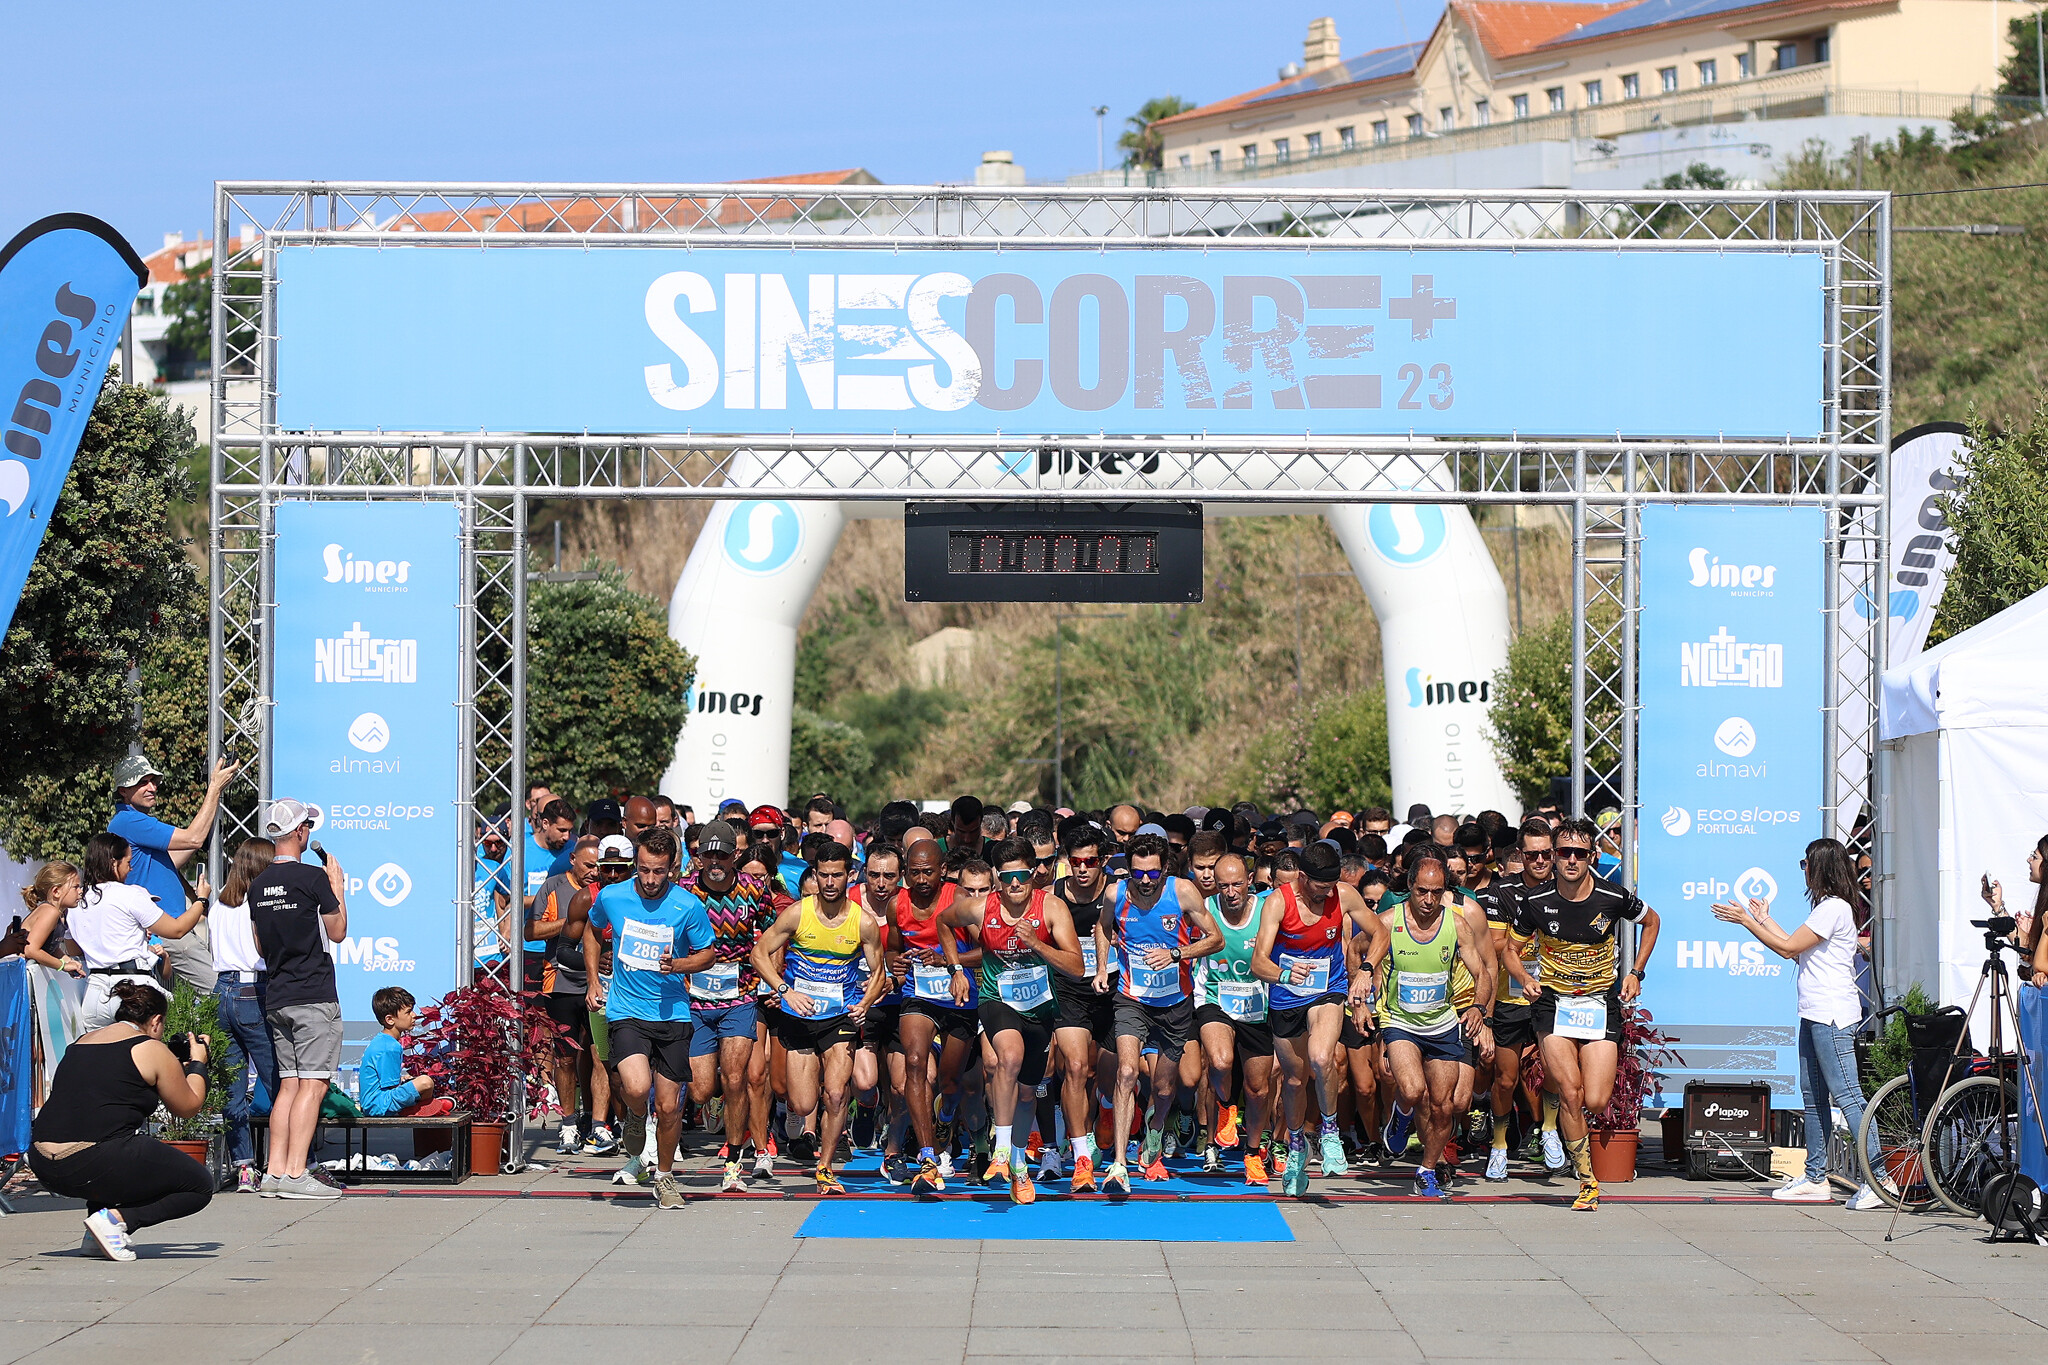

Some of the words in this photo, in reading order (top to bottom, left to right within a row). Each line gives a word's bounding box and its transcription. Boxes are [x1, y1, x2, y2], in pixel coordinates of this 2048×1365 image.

[68, 303, 116, 413] MUNICÍPIO
[1397, 362, 1456, 412] 23
[322, 543, 412, 584] Sines
[1688, 547, 1777, 588] Sines
[1730, 590, 1775, 598] MUNICÍPIO
[1405, 666, 1491, 709] Sines
[329, 755, 401, 774] almavi
[1696, 759, 1767, 778] almavi
[330, 819, 391, 830] PORTUGAL
[1697, 823, 1757, 835] PORTUGAL
[1681, 877, 1730, 901] galp
[631, 941, 660, 959] 286
[1677, 940, 1765, 969] HMS
[363, 959, 416, 972] SPORTS
[1728, 964, 1782, 977] SPORTS
[705, 976, 722, 991] 75
[927, 978, 951, 994] 102
[1143, 972, 1167, 986] 301
[1012, 983, 1039, 1001] 308
[1410, 988, 1437, 1003] 302
[1231, 998, 1253, 1013] 214
[1567, 1010, 1595, 1027] 386
[1718, 1108, 1749, 1118] lap2go
